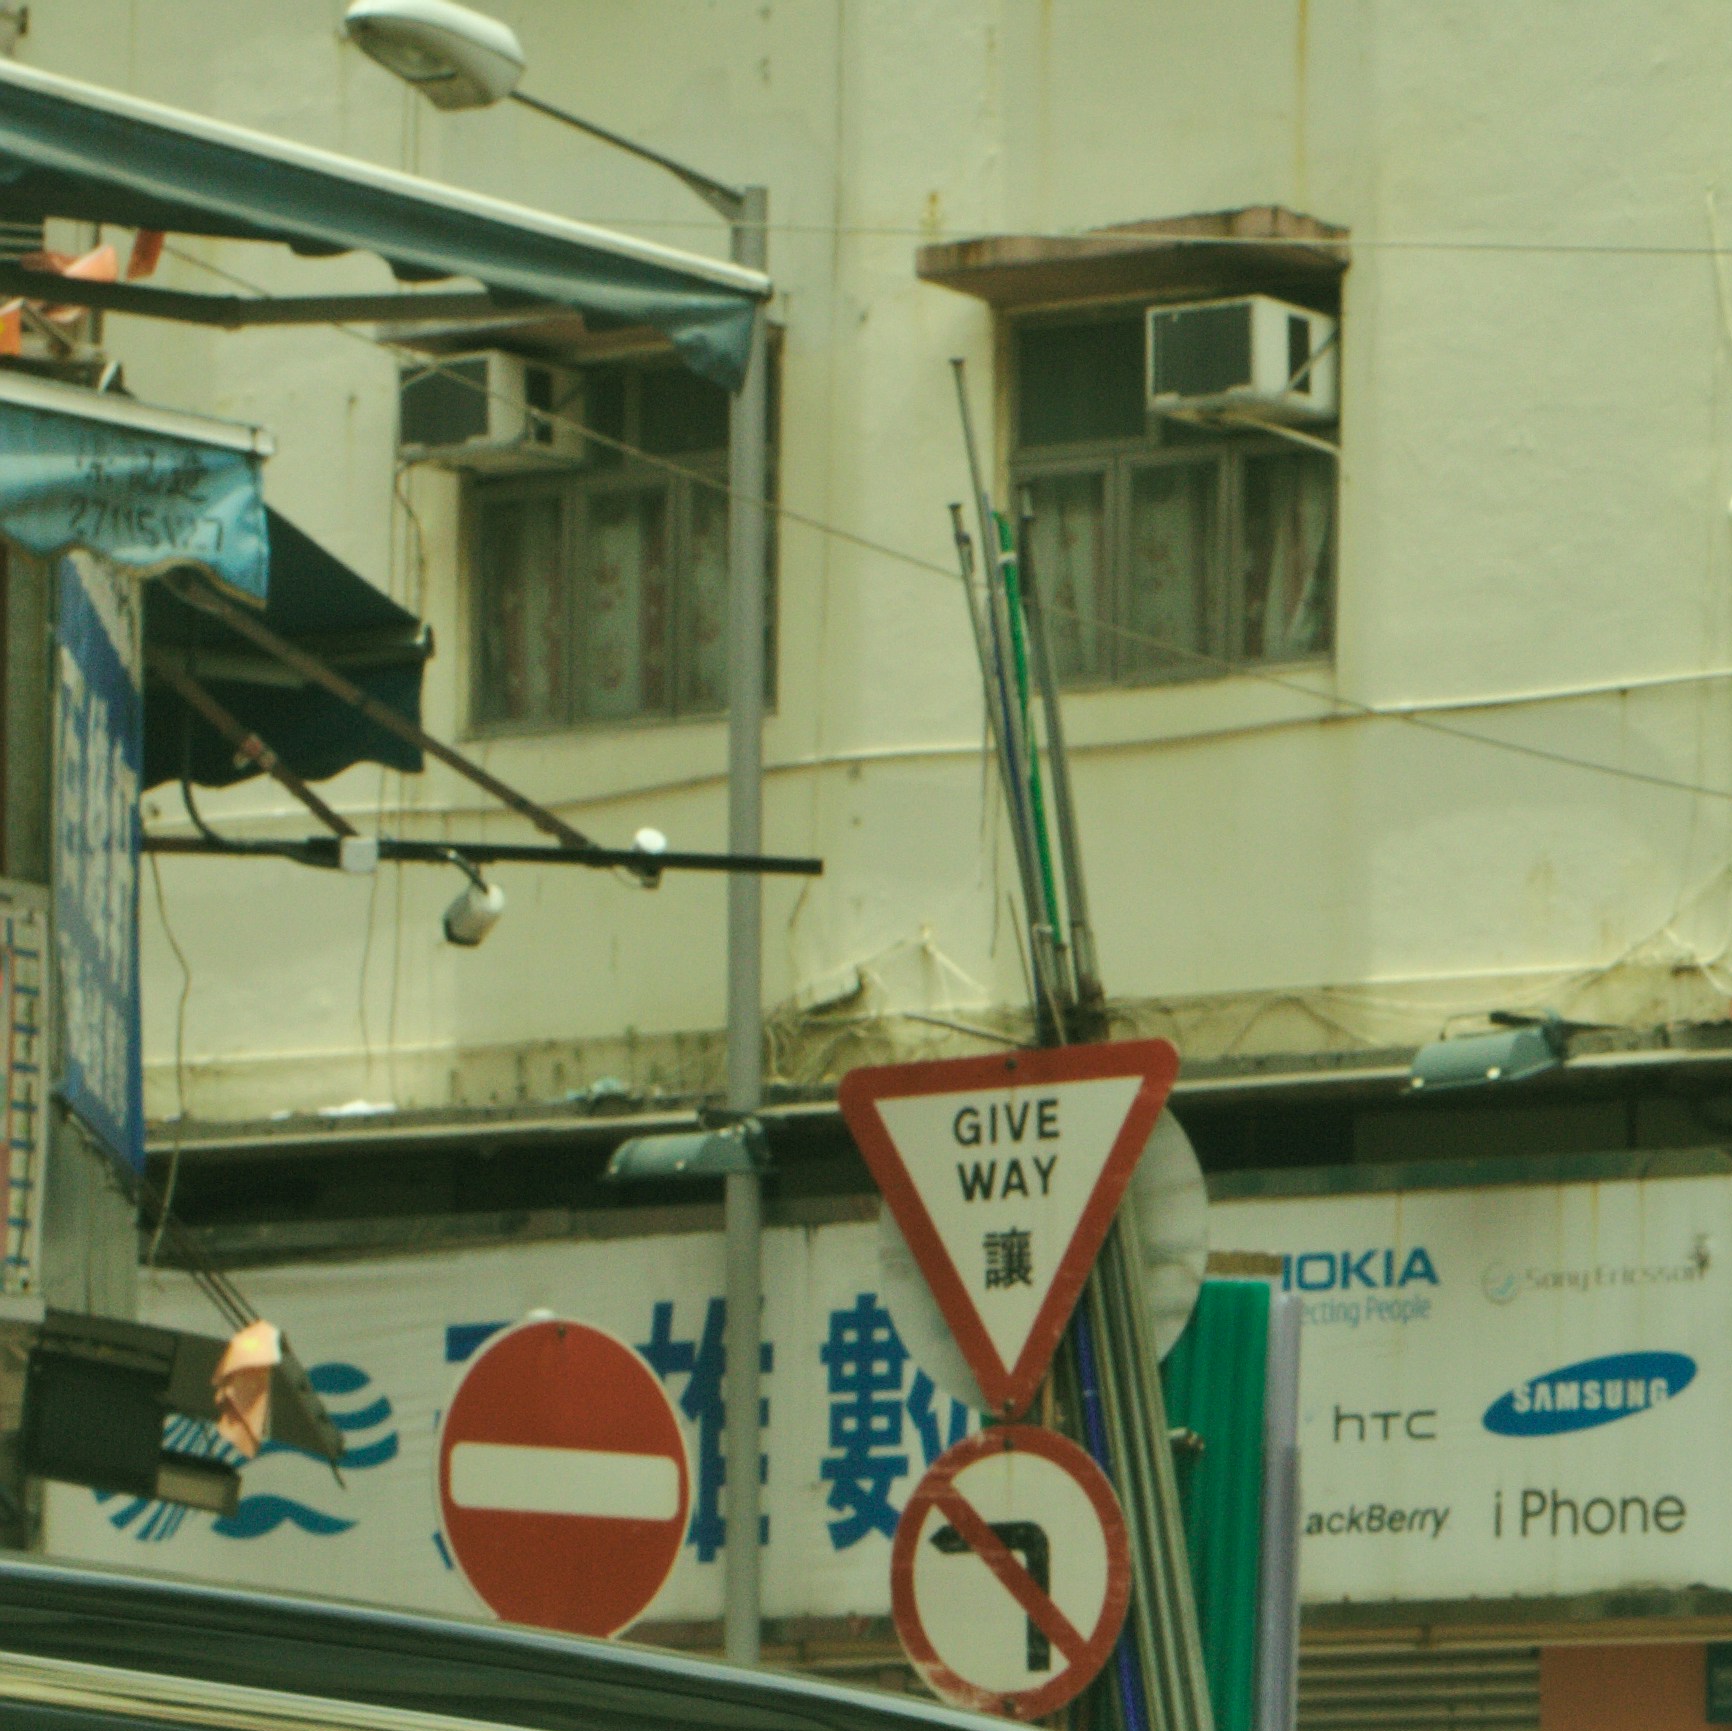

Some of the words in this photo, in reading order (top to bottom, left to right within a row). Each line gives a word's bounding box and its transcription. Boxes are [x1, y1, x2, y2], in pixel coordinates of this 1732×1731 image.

[953, 1099, 1060, 1145] GIVE
[956, 1155, 1057, 1202] WAY
[983, 1226, 1033, 1289] 讓
[1365, 1296, 1432, 1324] People
[1512, 1376, 1670, 1414] SAMSUNG
